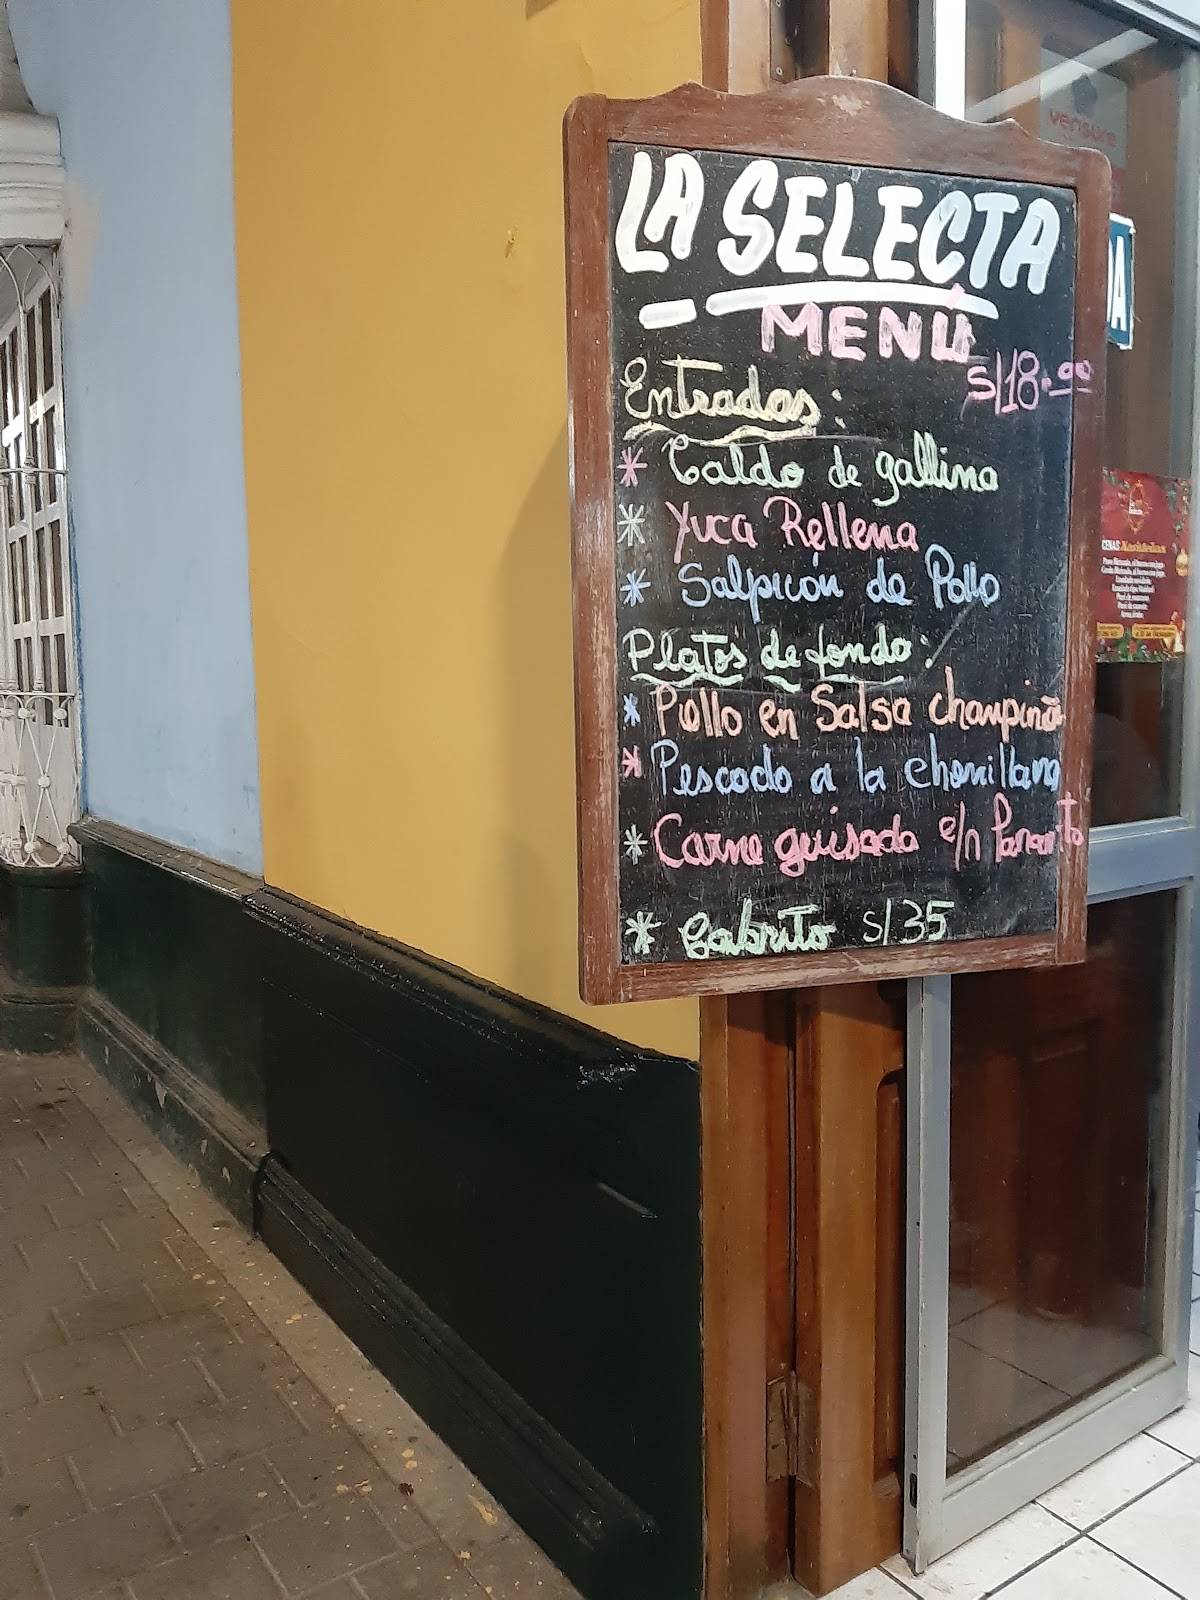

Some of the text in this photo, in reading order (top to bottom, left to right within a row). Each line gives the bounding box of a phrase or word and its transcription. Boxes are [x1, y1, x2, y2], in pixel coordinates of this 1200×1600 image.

[615, 151, 1060, 295] LA SELECTA
[661, 430, 1000, 507] Caldo de gallina
[665, 496, 919, 564] Yuca Rellena
[678, 543, 1000, 624] Salpicón de Pollo
[622, 627, 748, 674] Platos
[761, 628, 801, 670] de
[653, 683, 743, 737] Pollo
[759, 699, 800, 740] en
[811, 682, 912, 734] Salsa
[650, 740, 794, 796] Pescado
[810, 763, 838, 794] a
[855, 736, 885, 794] la
[652, 812, 763, 868] Carne
[774, 805, 920, 877] guisada
[678, 898, 836, 959] Cabrito
